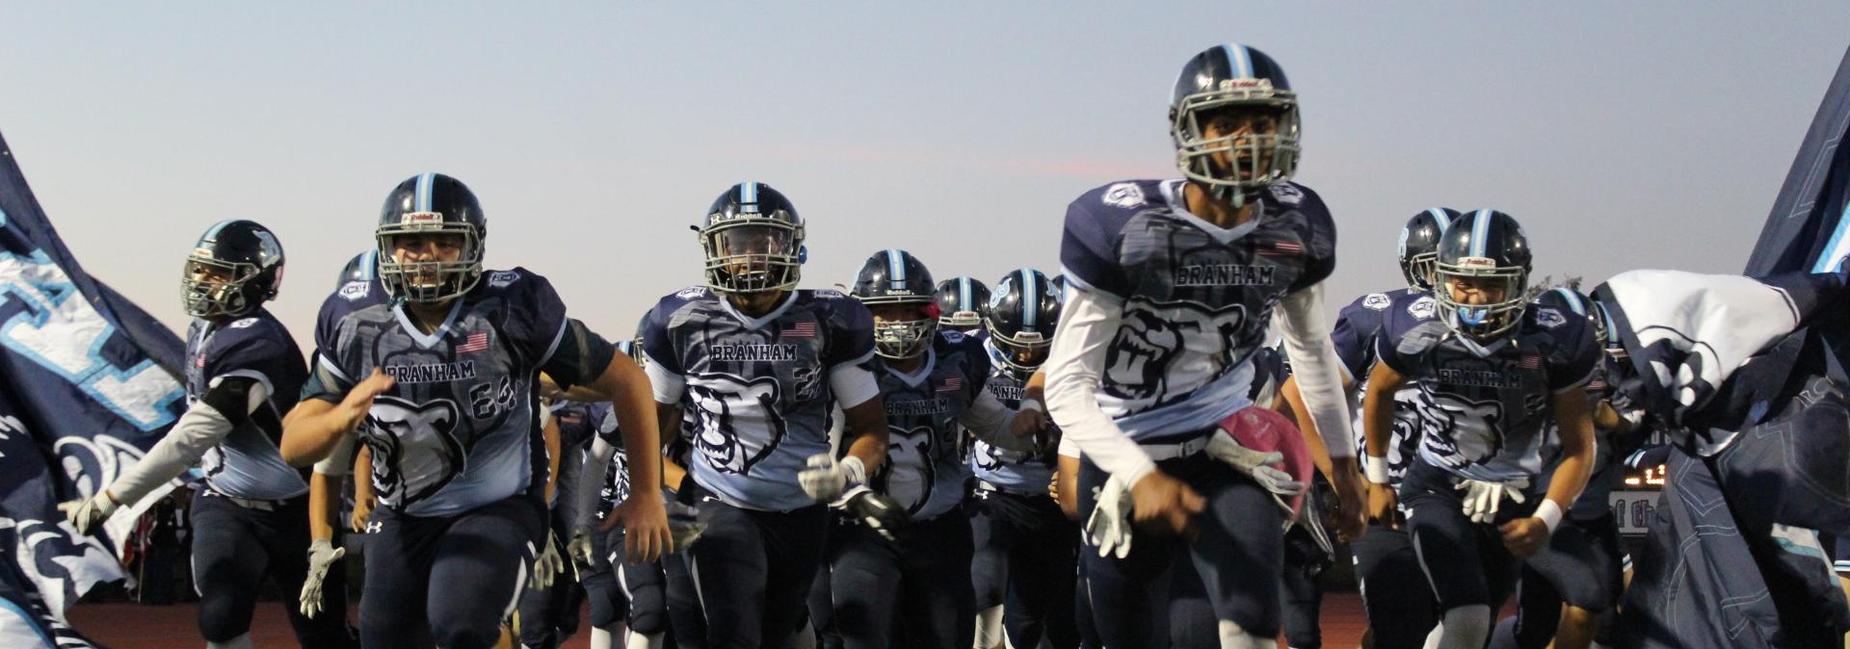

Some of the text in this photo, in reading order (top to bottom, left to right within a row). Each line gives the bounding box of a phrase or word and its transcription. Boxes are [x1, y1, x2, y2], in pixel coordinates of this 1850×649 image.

[1176, 263, 1277, 287] BRANHAM
[711, 344, 798, 361] BRANHAM
[1438, 367, 1522, 389] BRANHAM
[885, 397, 952, 416] BRANHAM
